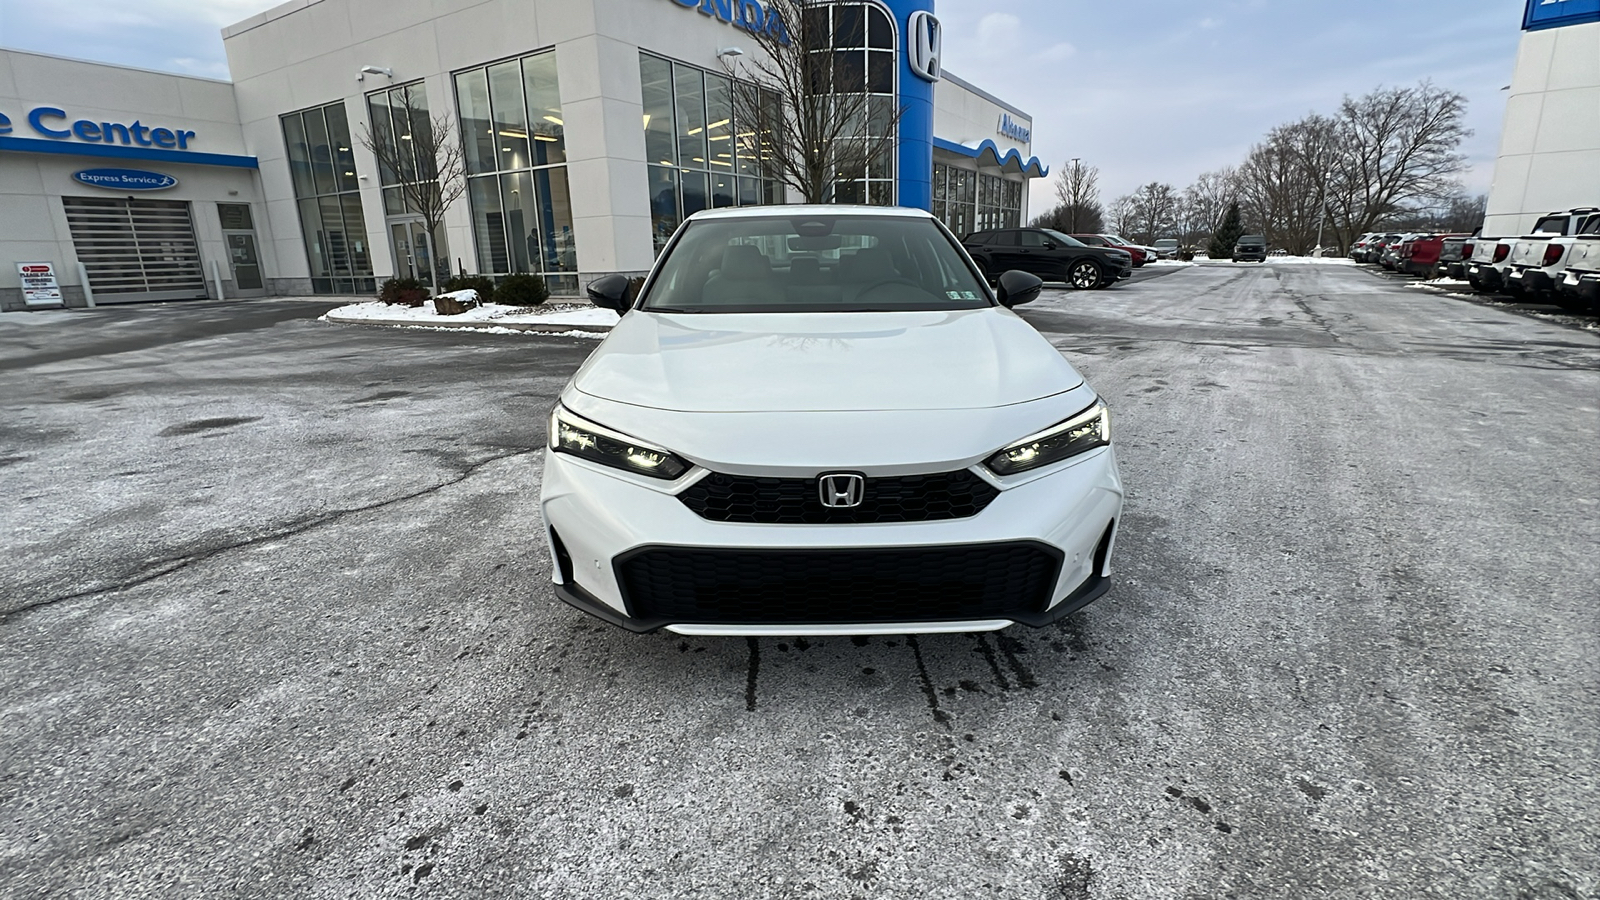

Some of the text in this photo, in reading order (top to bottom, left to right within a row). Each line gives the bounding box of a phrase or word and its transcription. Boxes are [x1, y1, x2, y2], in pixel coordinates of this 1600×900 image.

[28, 106, 195, 149] Center
[80, 172, 157, 184] Express Service
